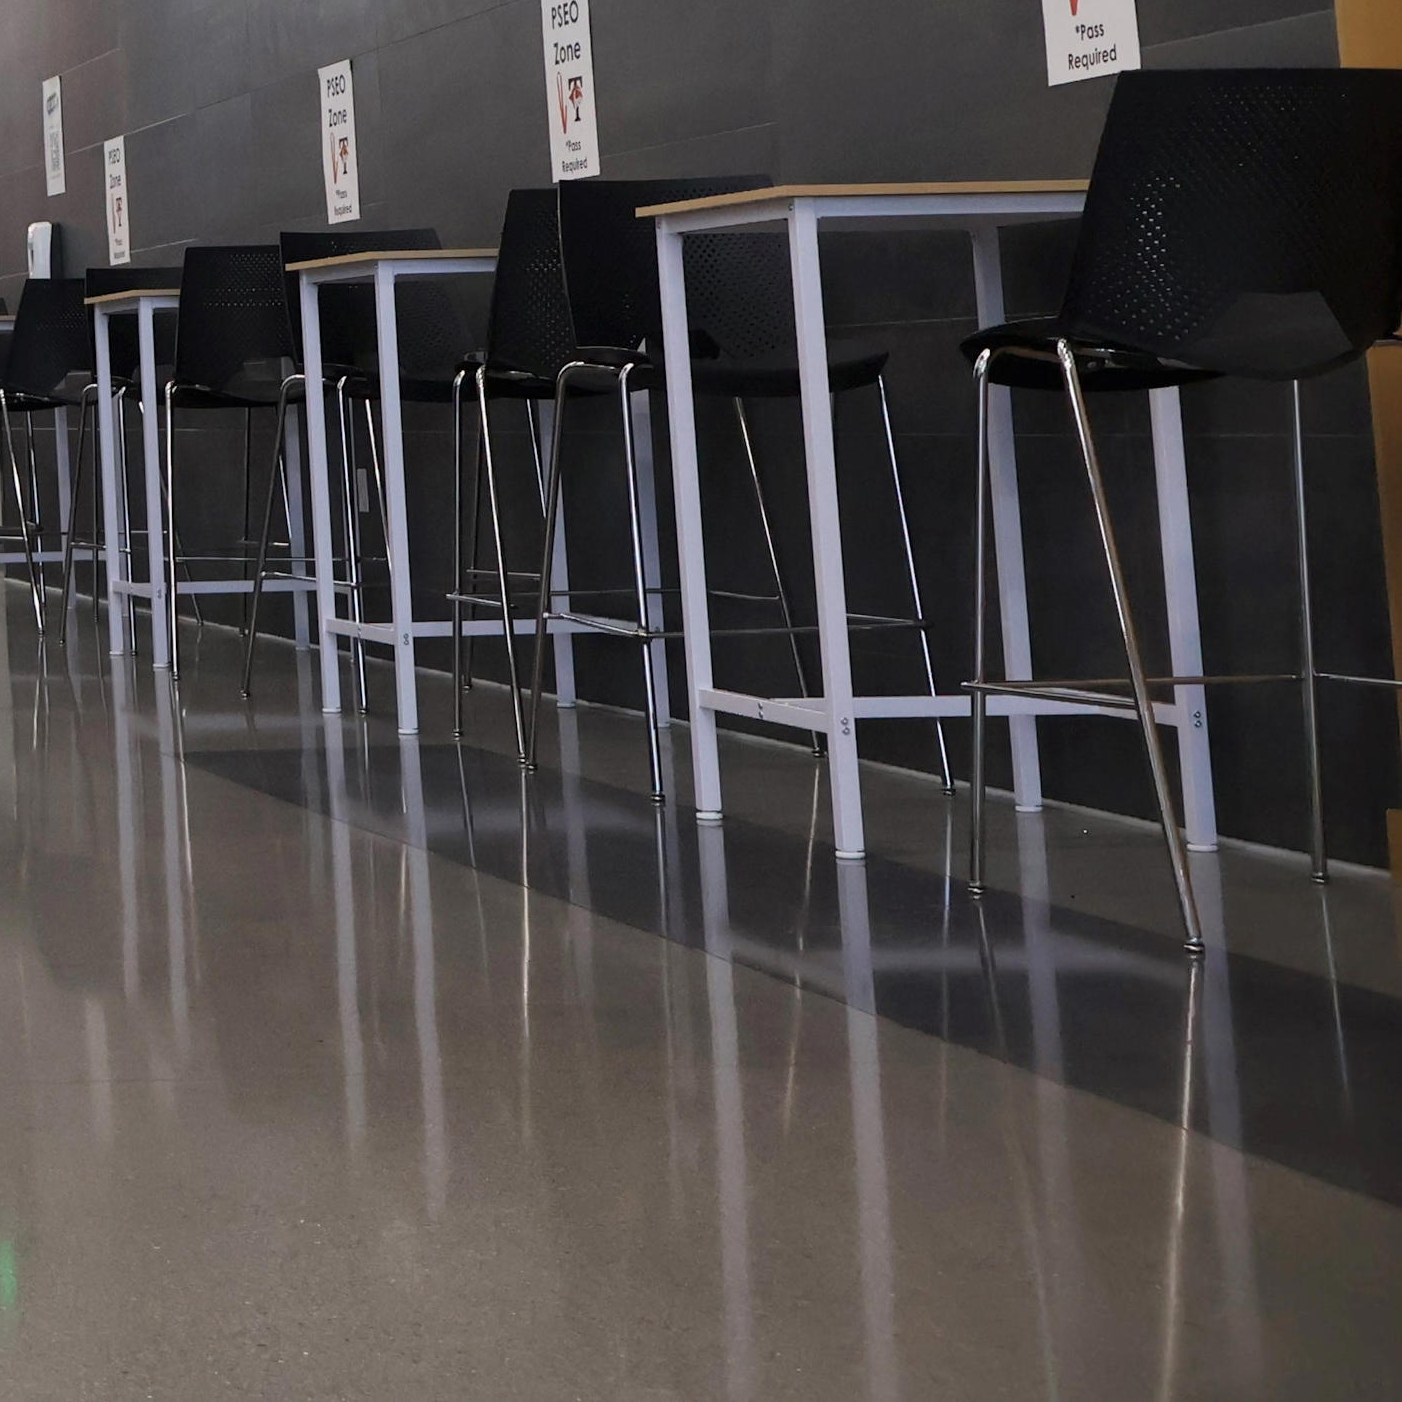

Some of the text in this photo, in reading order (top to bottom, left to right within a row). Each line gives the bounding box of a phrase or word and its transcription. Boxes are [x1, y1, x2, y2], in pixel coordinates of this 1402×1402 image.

[551, 0, 580, 30] PSEO
[553, 41, 582, 66] Zone
[1068, 42, 1117, 71] Required
[327, 74, 346, 98] PSEO
[328, 108, 348, 128] Zone
